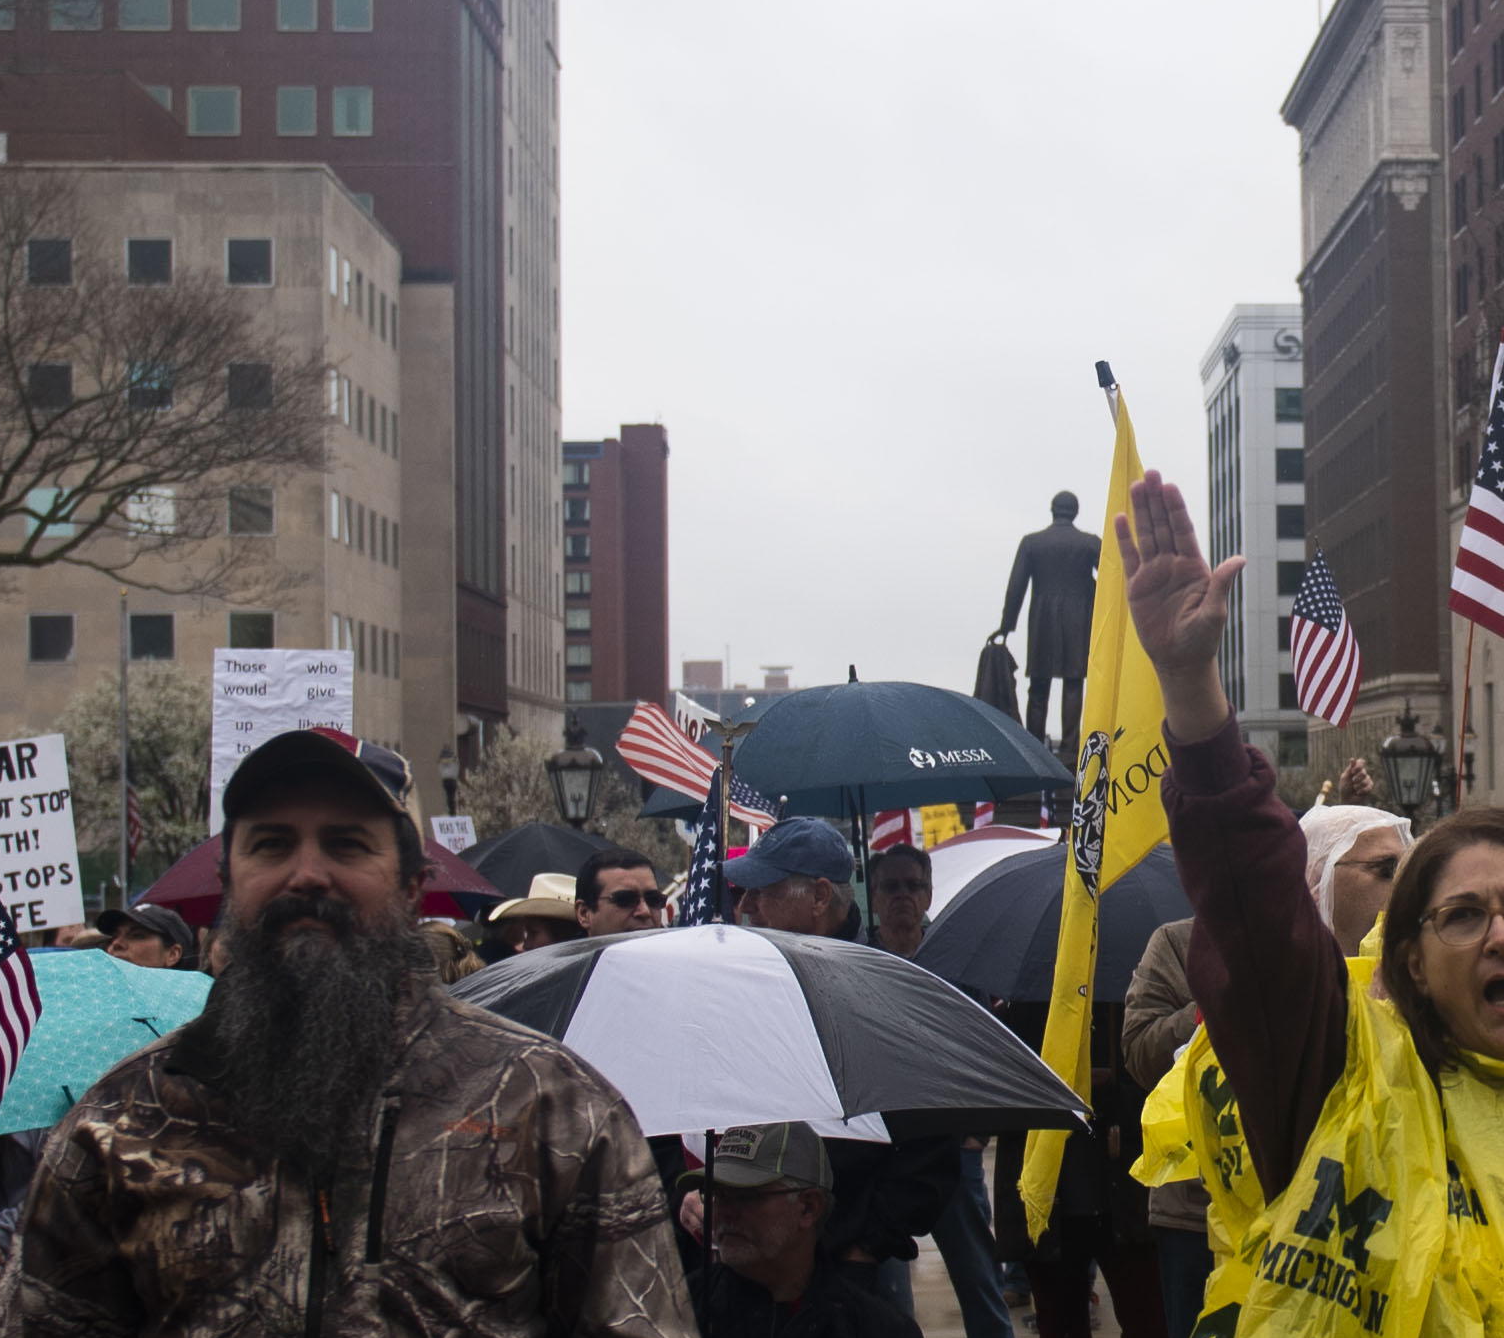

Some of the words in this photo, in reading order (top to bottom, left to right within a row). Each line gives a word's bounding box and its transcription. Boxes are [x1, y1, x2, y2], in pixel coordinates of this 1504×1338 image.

[225, 659, 267, 674] Those
[307, 662, 338, 675] who
[223, 683, 267, 697] would
[307, 686, 336, 700] give
[235, 721, 254, 732] up
[937, 748, 993, 763] MESSA
[20, 789, 70, 817] STOP
